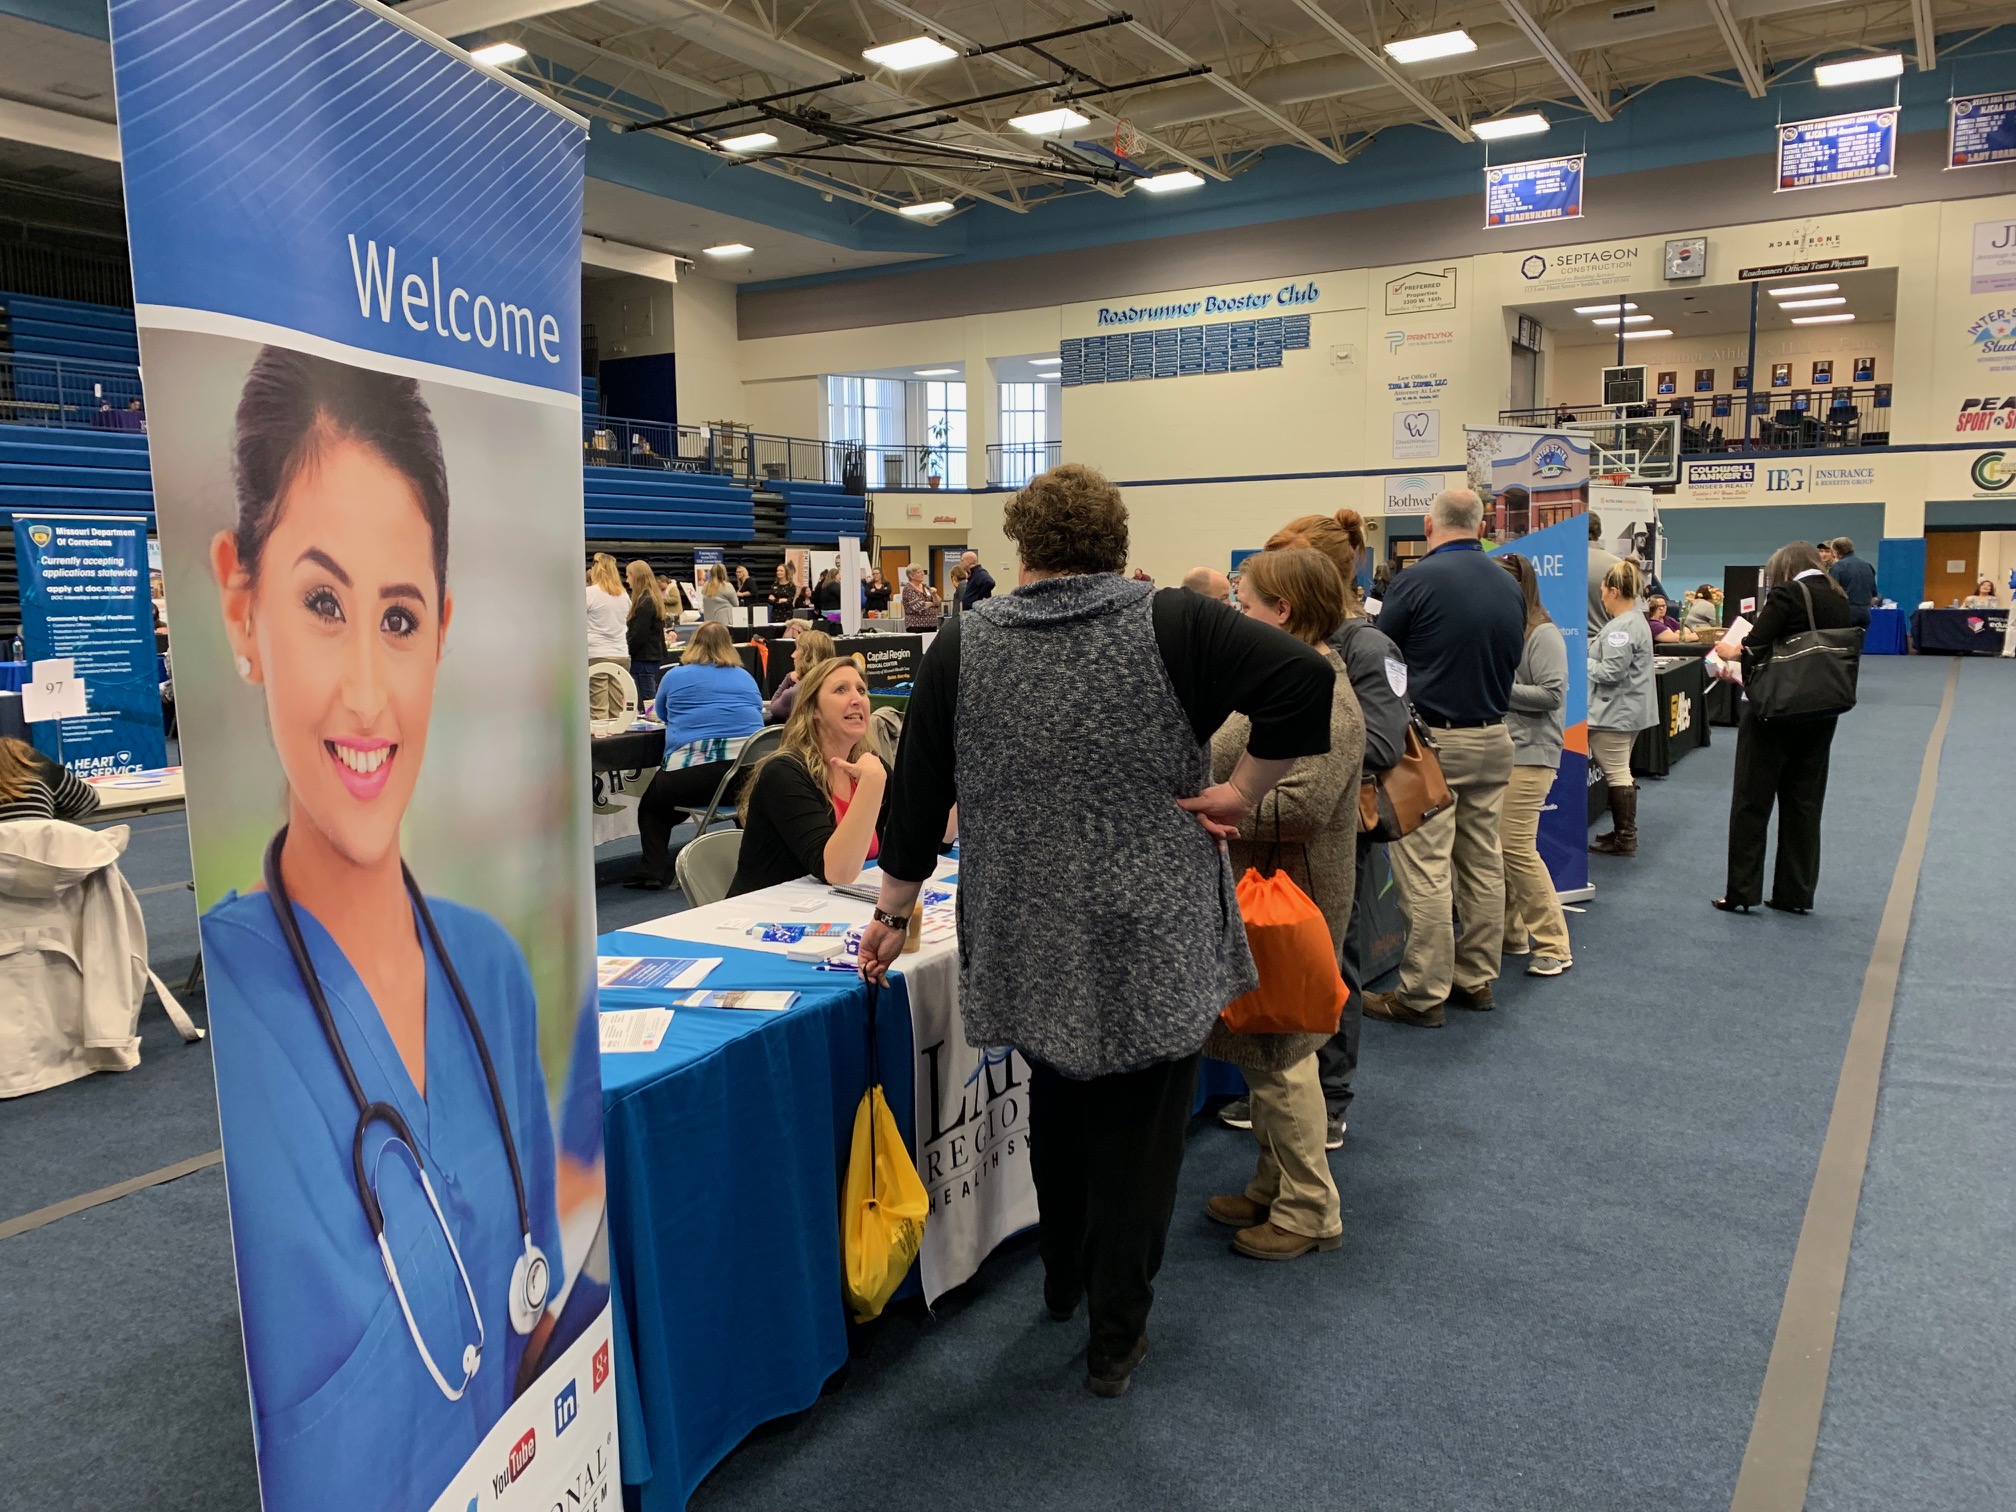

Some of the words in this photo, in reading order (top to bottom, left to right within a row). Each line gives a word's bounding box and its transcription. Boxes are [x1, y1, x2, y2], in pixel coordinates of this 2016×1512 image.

[1809, 235, 1840, 244] BONE
[1557, 248, 1638, 266] SEPTAGON
[1561, 262, 1632, 274] CONSTRUCTION
[1742, 268, 1782, 278] Roadrunners
[1784, 264, 1810, 273] Official
[1811, 262, 1829, 271] Team
[1830, 259, 1865, 269] Physicians
[1404, 282, 1441, 291] PREFERRED
[348, 234, 560, 363] Welcome
[1097, 301, 1200, 326] Roadrunner
[1204, 293, 1272, 313] Booster
[1276, 282, 1320, 305] Club
[1407, 331, 1453, 341] PRINTLYNX
[1956, 412, 1995, 432] SPORT
[1766, 468, 1804, 491] IBG
[1816, 468, 1874, 479] INSURANCE
[56, 527, 90, 535] Missouri
[91, 528, 135, 537] Department
[68, 538, 112, 547] Corrections
[41, 556, 81, 566] Currently
[83, 557, 124, 567] accepting
[42, 568, 95, 578] applications
[97, 569, 138, 577] statewide
[46, 585, 72, 594] apply
[85, 585, 136, 593] doc.mo.gov
[867, 650, 888, 662] Capital
[889, 649, 910, 660] Region
[46, 682, 62, 695] 97
[65, 762, 73, 770] A
[75, 756, 115, 769] HEART
[75, 770, 89, 778] for
[90, 764, 143, 777] SERVICE
[926, 1098, 1030, 1185] REGIO
[929, 1152, 999, 1216] HEALTH
[557, 1394, 575, 1429] in
[492, 1438, 535, 1500] YouTube
